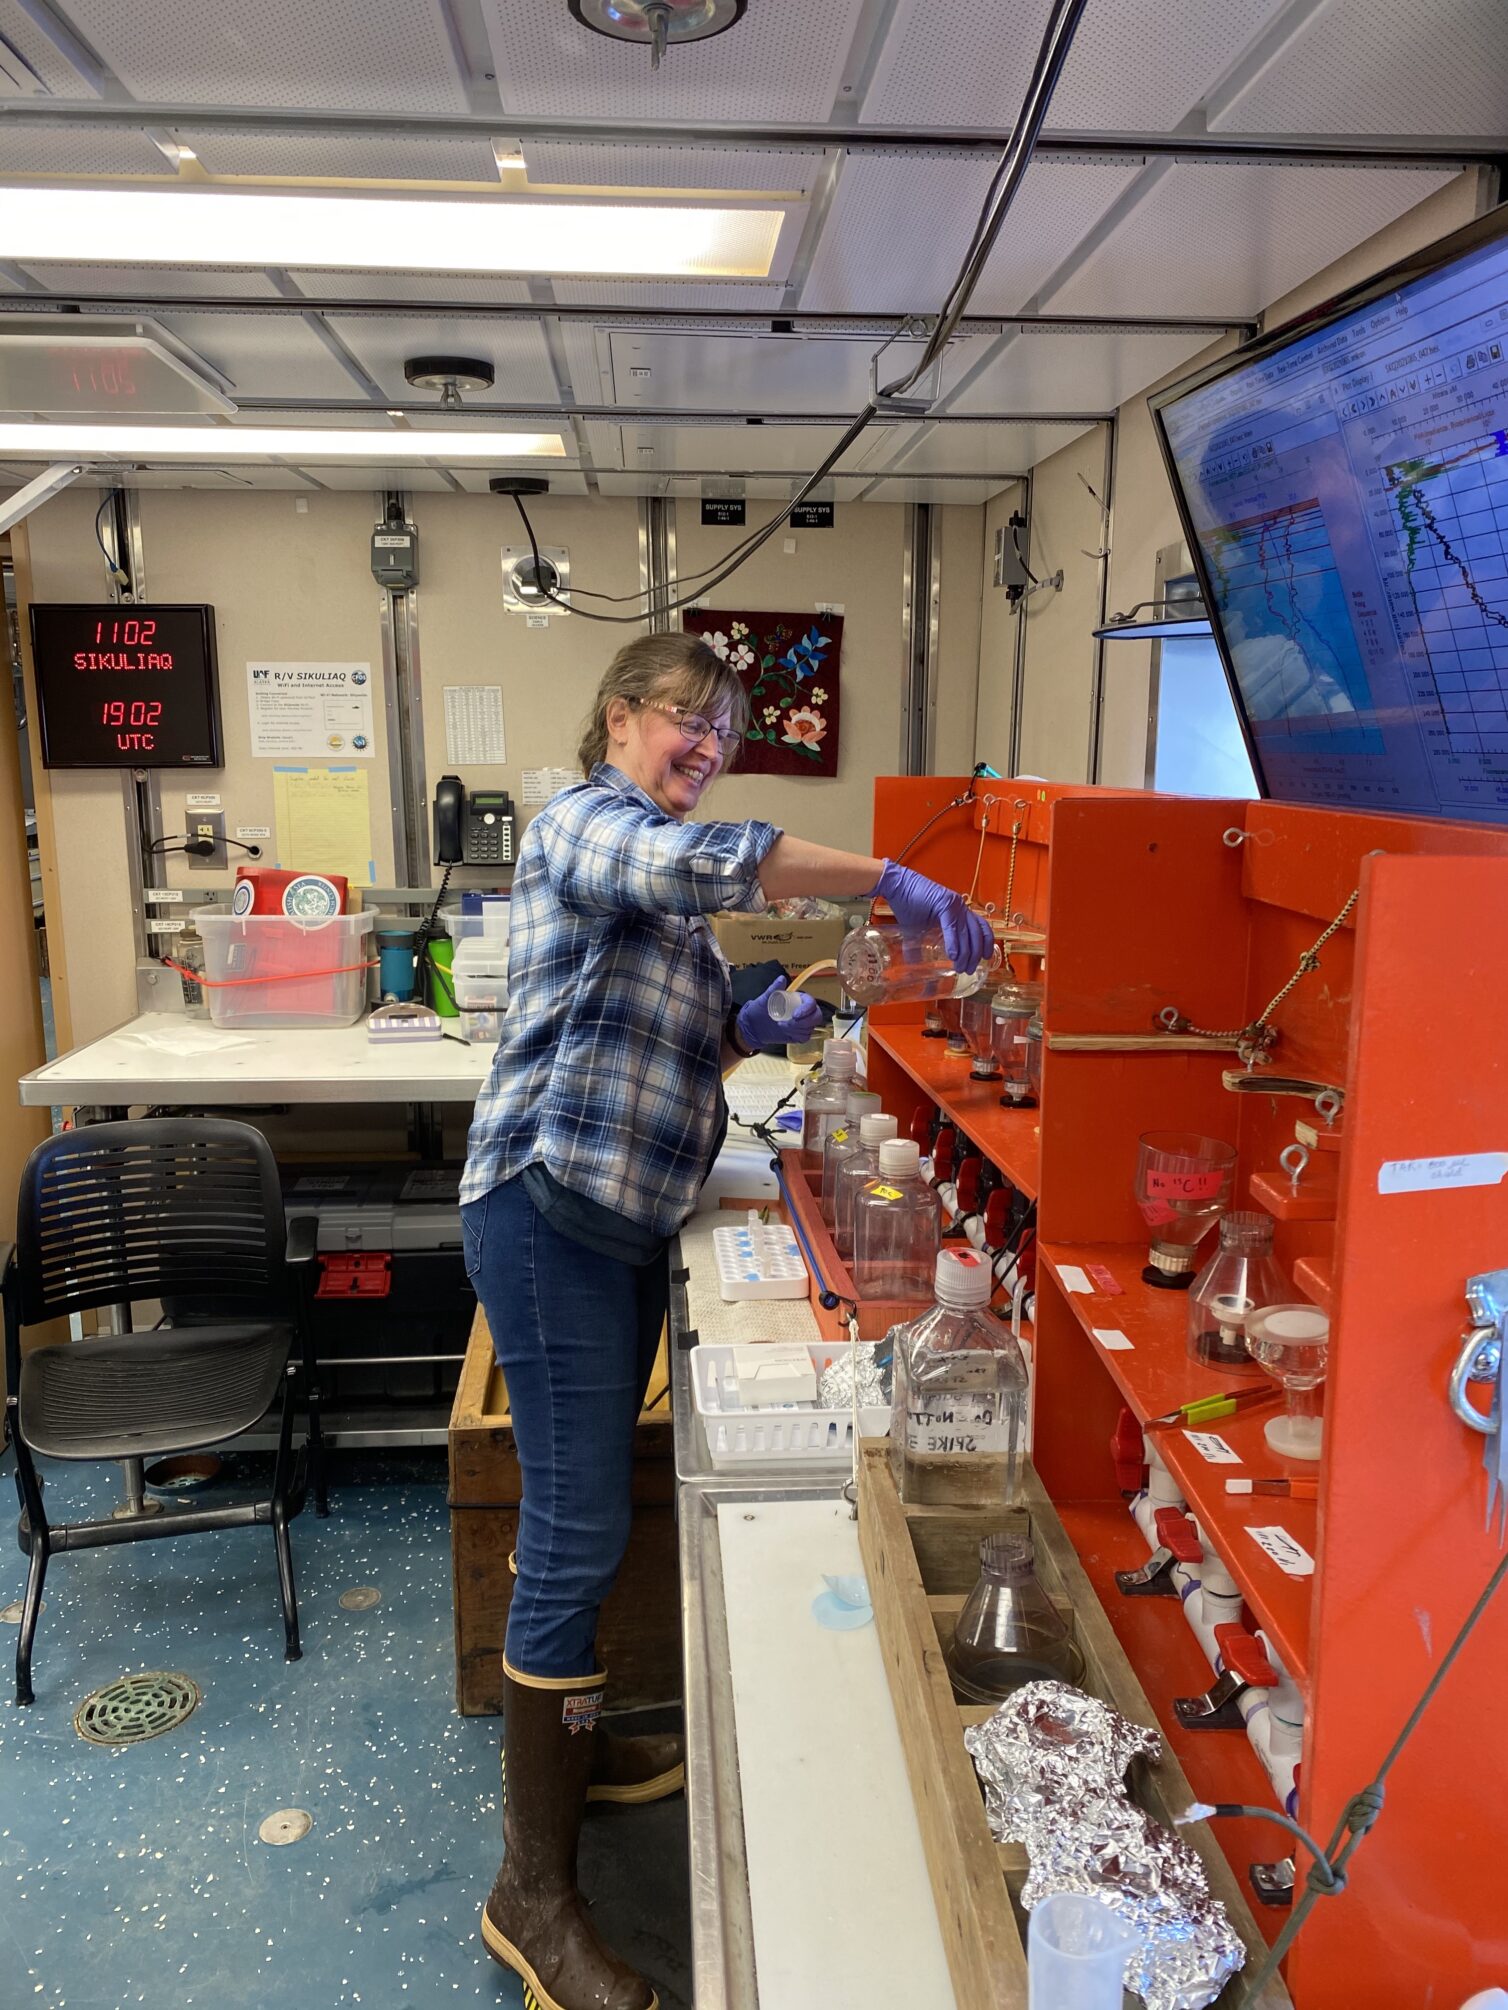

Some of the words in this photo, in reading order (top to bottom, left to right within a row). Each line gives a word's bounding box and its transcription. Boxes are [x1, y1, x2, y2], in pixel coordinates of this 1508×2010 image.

[705, 503, 728, 511] SUPPLY
[96, 621, 156, 645] 1102
[74, 653, 174, 670] SIKULIAQ
[274, 672, 294, 682] R/V
[297, 672, 347, 682] SIKULIAQ
[103, 702, 162, 726] 1902
[117, 734, 155, 750] UTC
